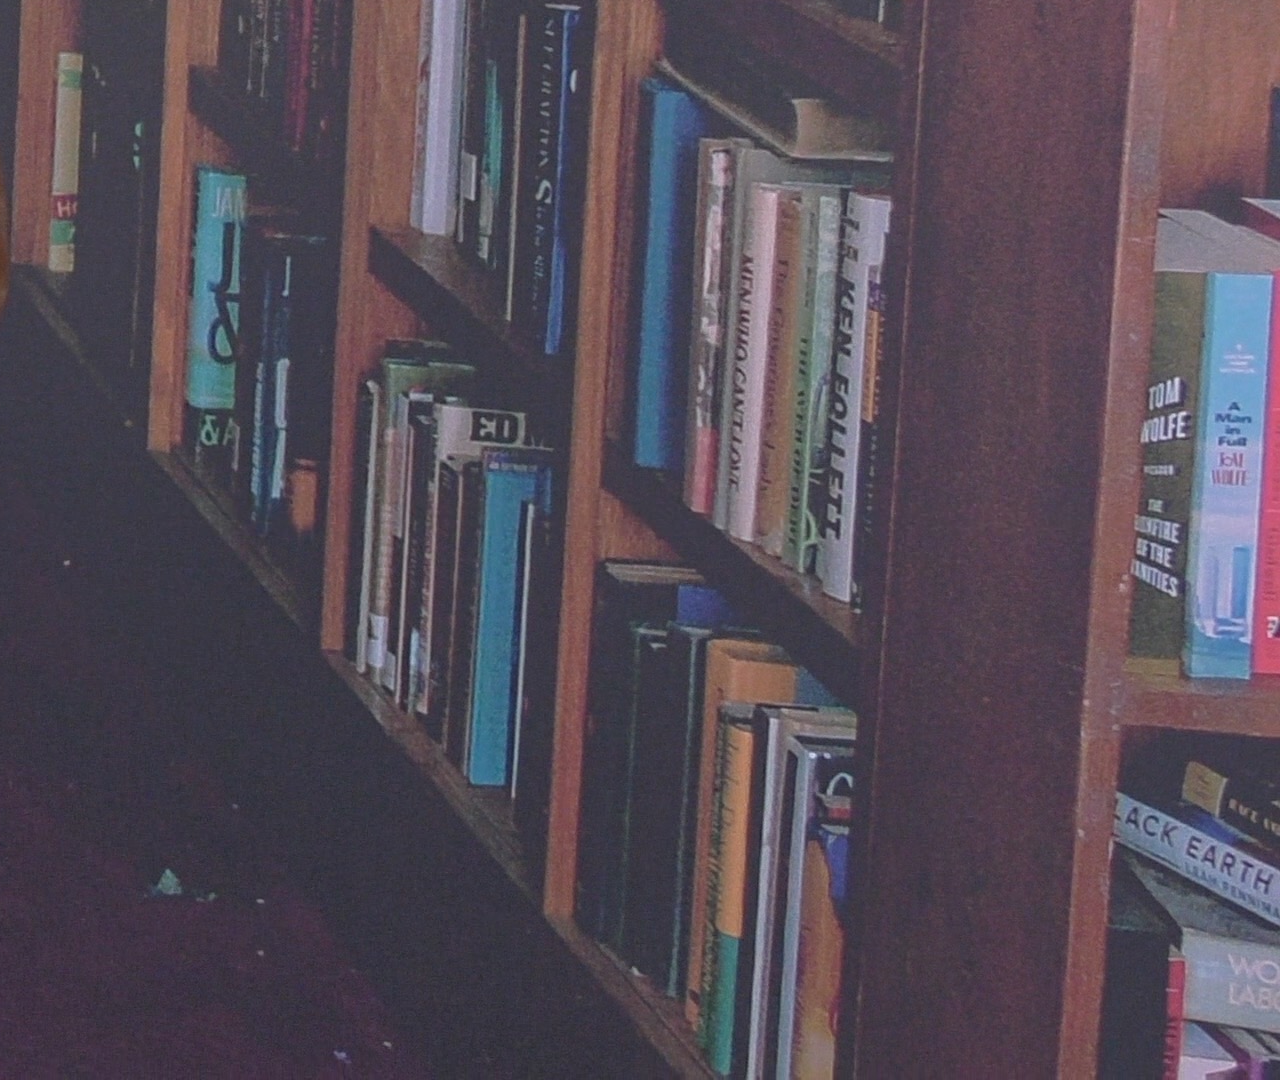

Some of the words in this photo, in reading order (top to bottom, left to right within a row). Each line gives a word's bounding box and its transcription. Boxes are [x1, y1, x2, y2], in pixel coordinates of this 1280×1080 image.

[741, 254, 755, 304] MEN
[834, 277, 856, 358] KEN
[735, 309, 752, 361] WHO
[1148, 377, 1181, 411] TOM
[1228, 402, 1241, 411] A
[1140, 411, 1187, 443] WOLFE
[1214, 412, 1253, 424] Man
[1225, 424, 1242, 435] in
[821, 371, 850, 540] FOLLETT
[1217, 435, 1248, 447] Full
[729, 437, 741, 494] LOVE
[1147, 499, 1163, 513] THE
[1133, 514, 1181, 544] BONFIRE
[1150, 542, 1173, 568] THE
[1184, 835, 1275, 895] EARTH
